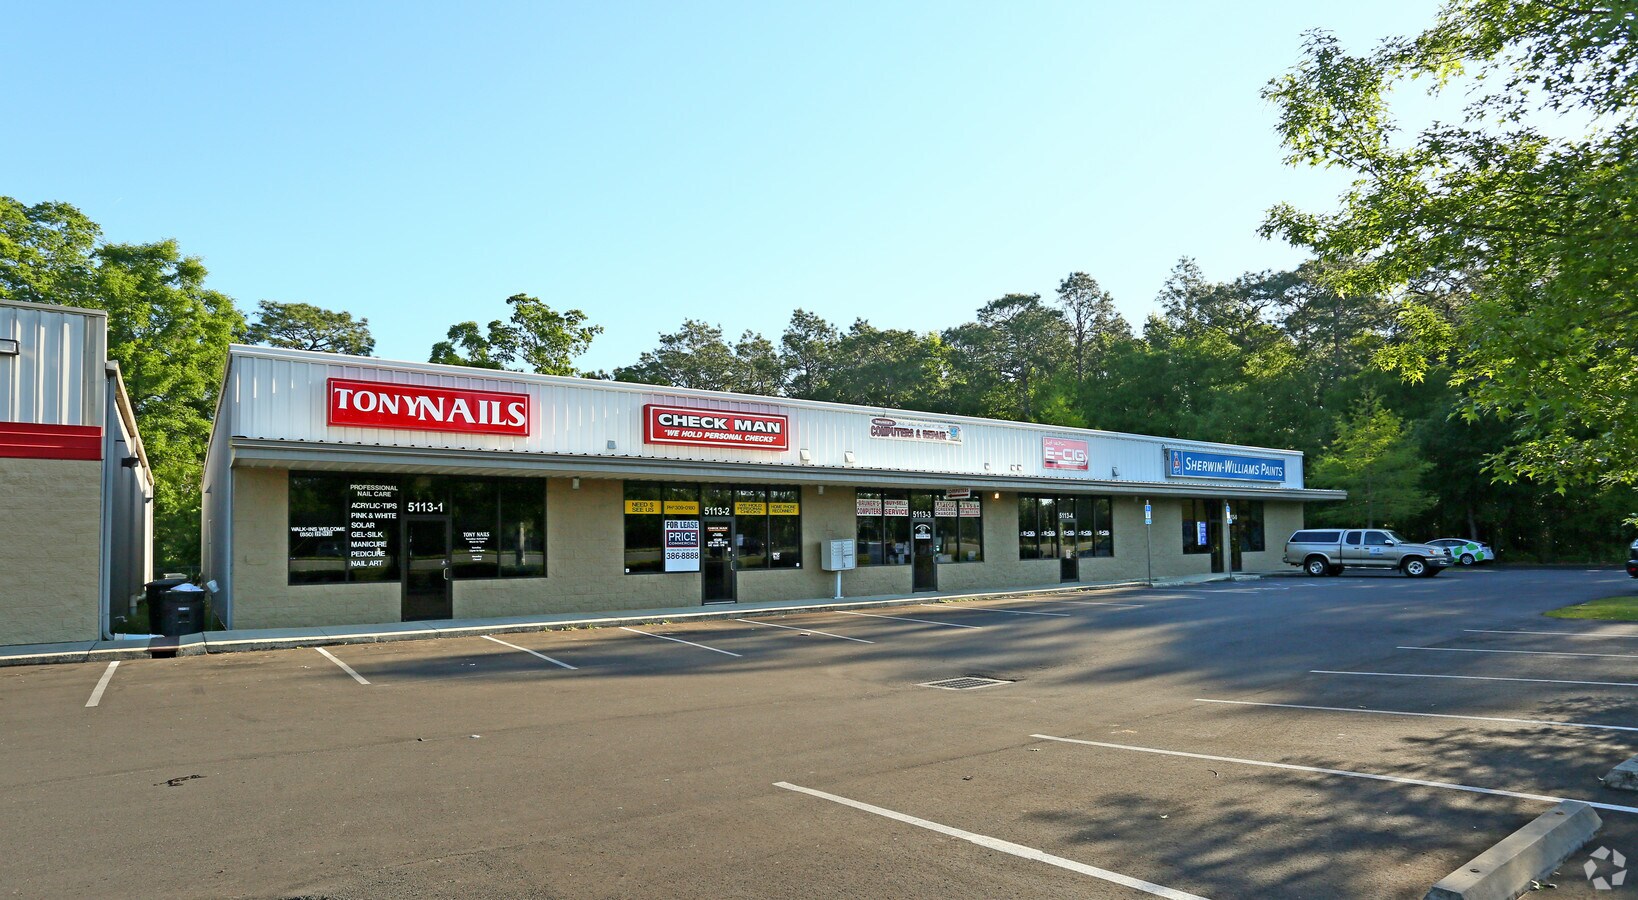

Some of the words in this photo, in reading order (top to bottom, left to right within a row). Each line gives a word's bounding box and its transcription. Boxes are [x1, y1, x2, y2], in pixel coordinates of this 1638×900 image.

[658, 414, 728, 430] CHECK
[734, 419, 780, 433] MAN
[681, 430, 702, 438] HOLD
[704, 432, 743, 441] PERSONAL
[871, 425, 914, 439] COMPUTERS
[916, 429, 921, 438] &
[922, 430, 946, 440] REPAIR
[1045, 446, 1085, 462] E-CIG
[1261, 463, 1283, 477] PAINTS
[407, 502, 443, 512] 5113-1
[704, 507, 730, 515] 5113-2
[884, 508, 908, 516] SERVICE
[666, 521, 678, 529] FOR
[680, 521, 698, 529] LEASE
[668, 532, 697, 541] PRICE
[666, 552, 699, 560] 386-8888
